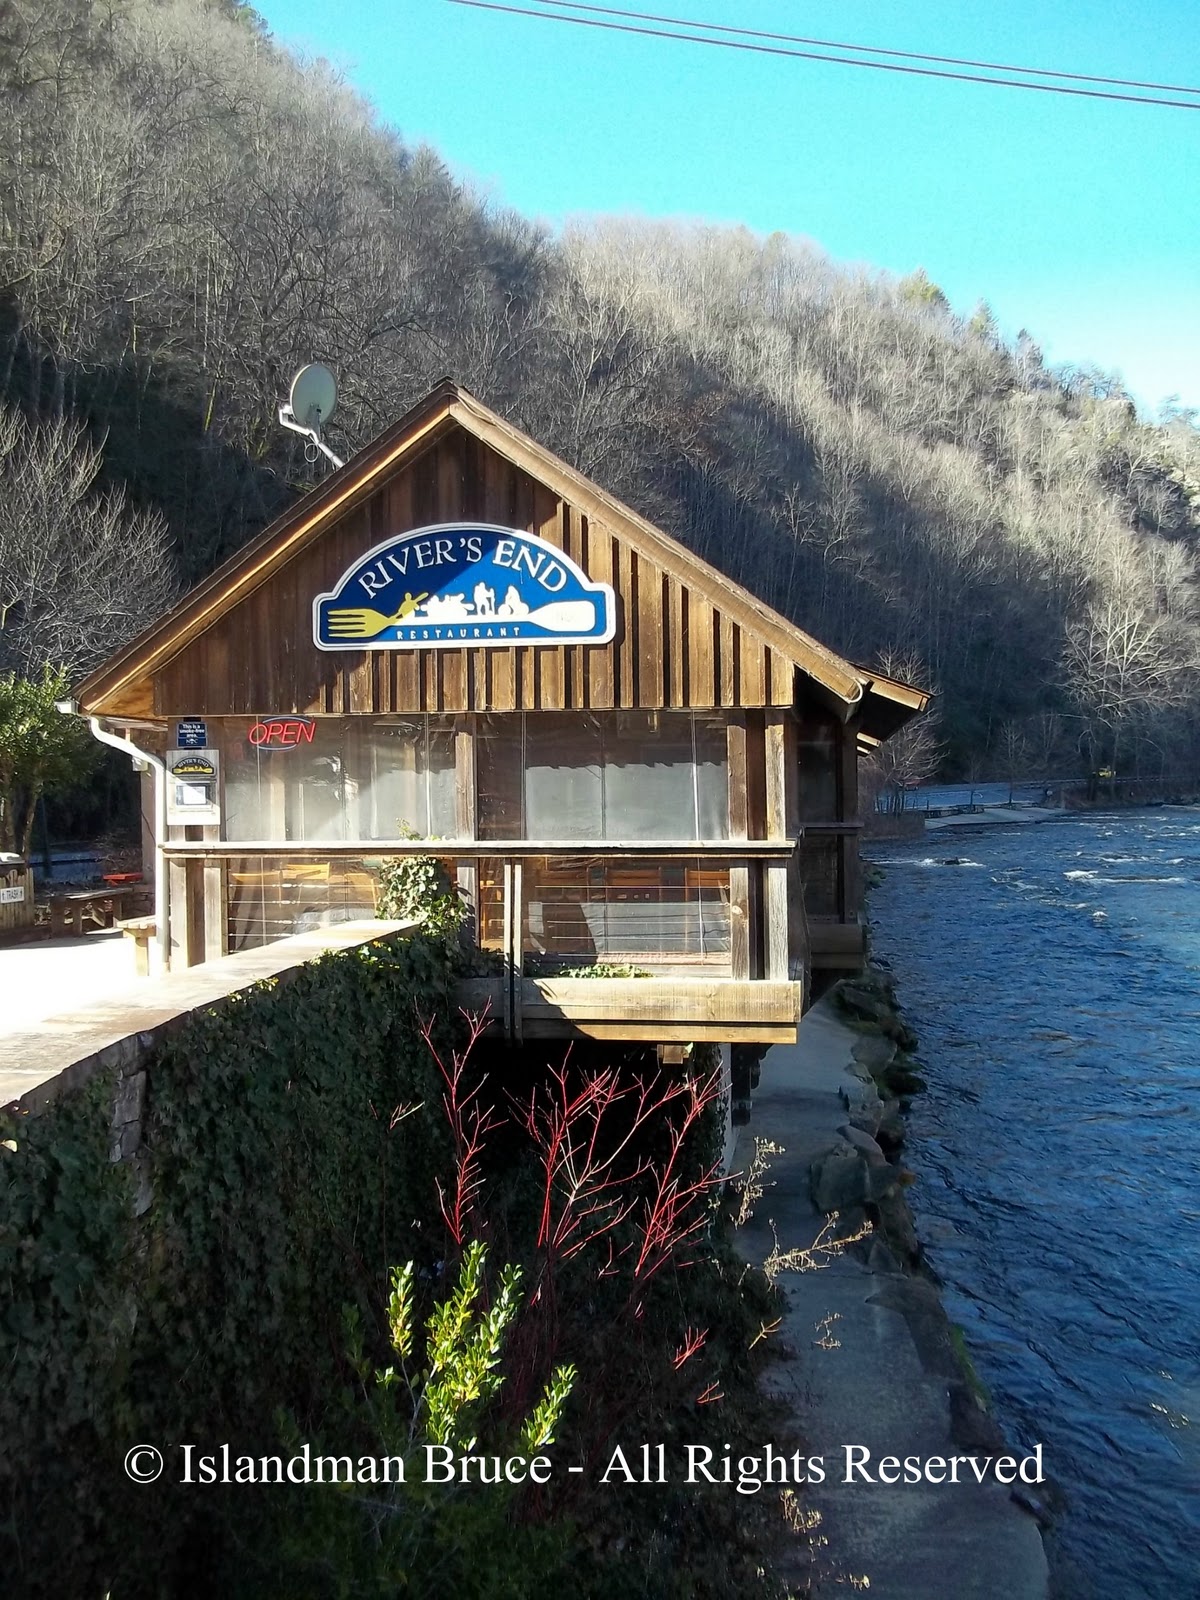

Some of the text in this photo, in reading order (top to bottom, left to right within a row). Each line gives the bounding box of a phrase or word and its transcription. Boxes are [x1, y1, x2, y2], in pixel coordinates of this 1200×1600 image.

[358, 537, 567, 599] RIVER'S END
[396, 626, 521, 640] RESTAURANT
[248, 721, 316, 745] OPEN
